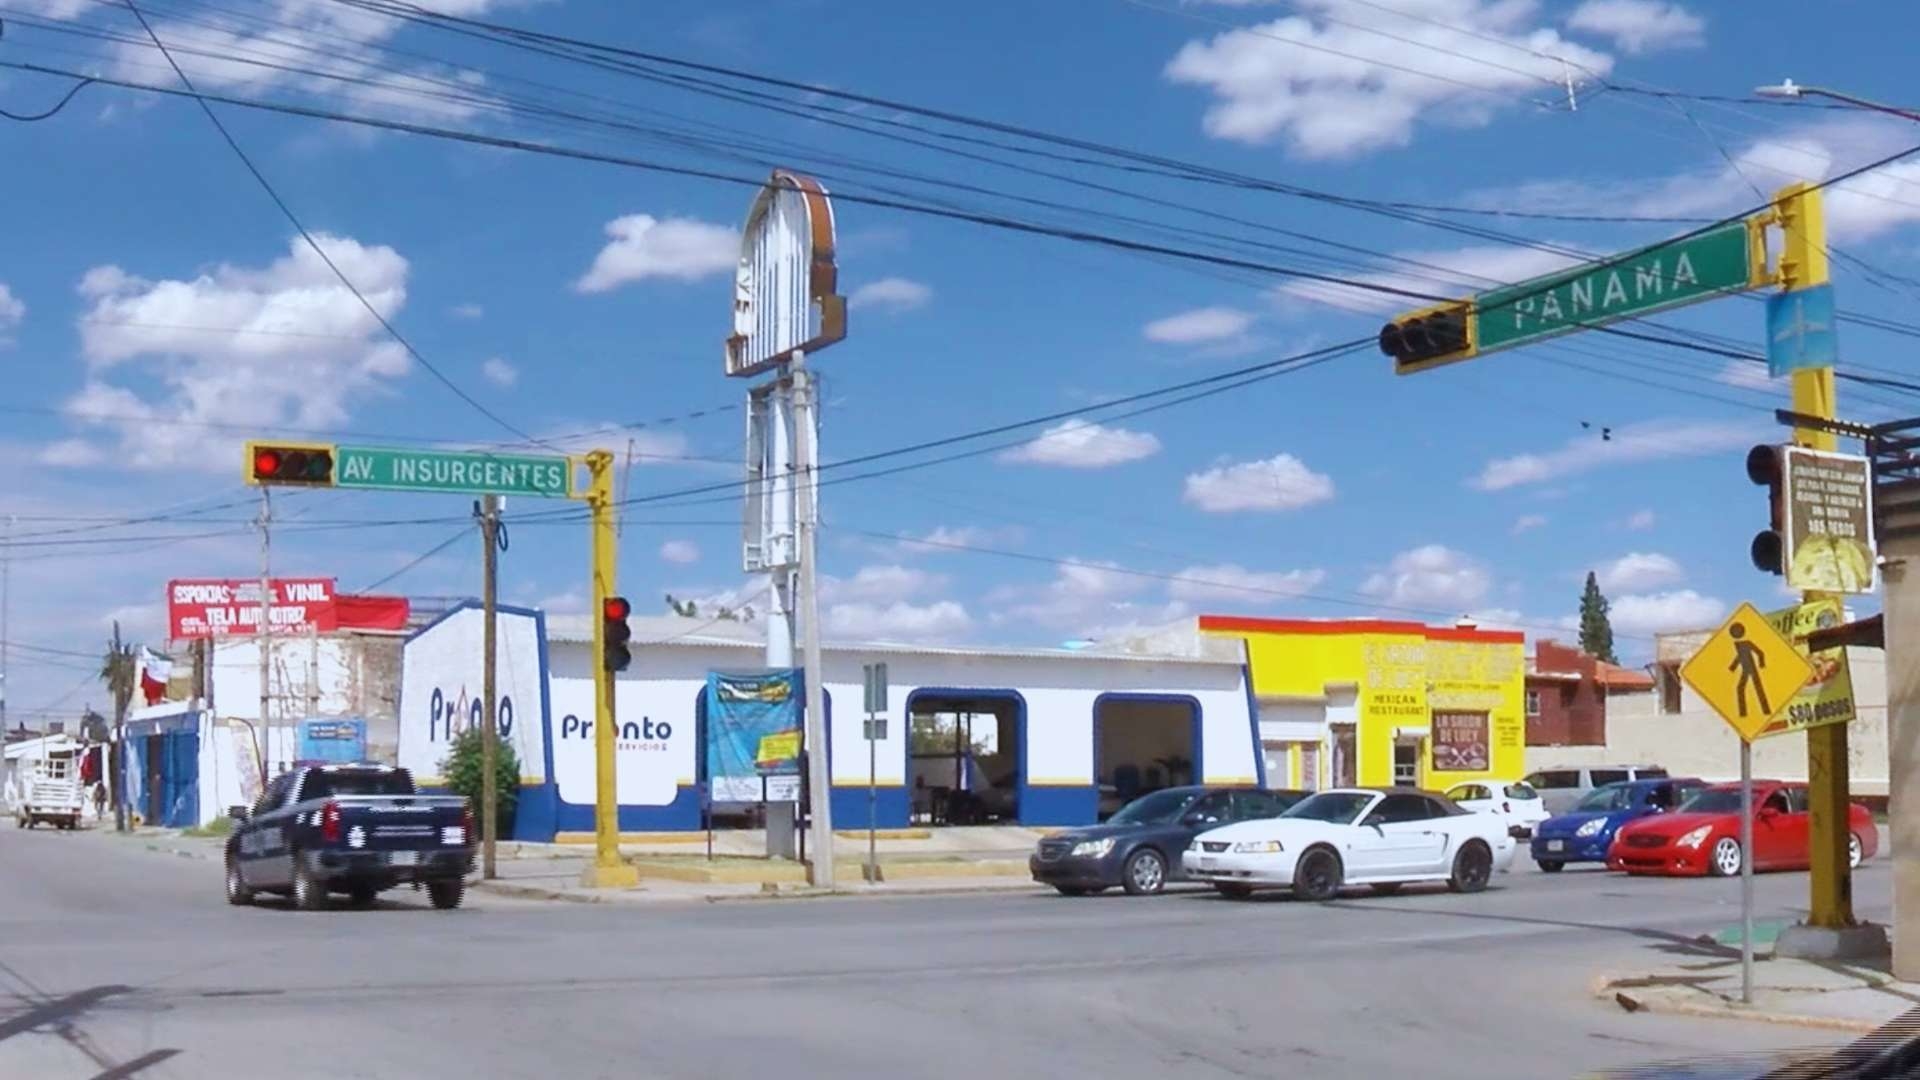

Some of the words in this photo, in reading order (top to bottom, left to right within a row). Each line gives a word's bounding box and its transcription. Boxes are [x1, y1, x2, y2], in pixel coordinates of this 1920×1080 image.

[1515, 253, 1699, 330] PANAMA
[343, 457, 375, 479] AV.
[393, 459, 561, 488] INSURGENTES
[285, 584, 329, 602] VINIL
[206, 607, 237, 625] TELA
[1772, 611, 1814, 635] offee
[1374, 694, 1417, 704] MEXICAN
[431, 685, 512, 742] Prono
[562, 714, 672, 739] Prnto
